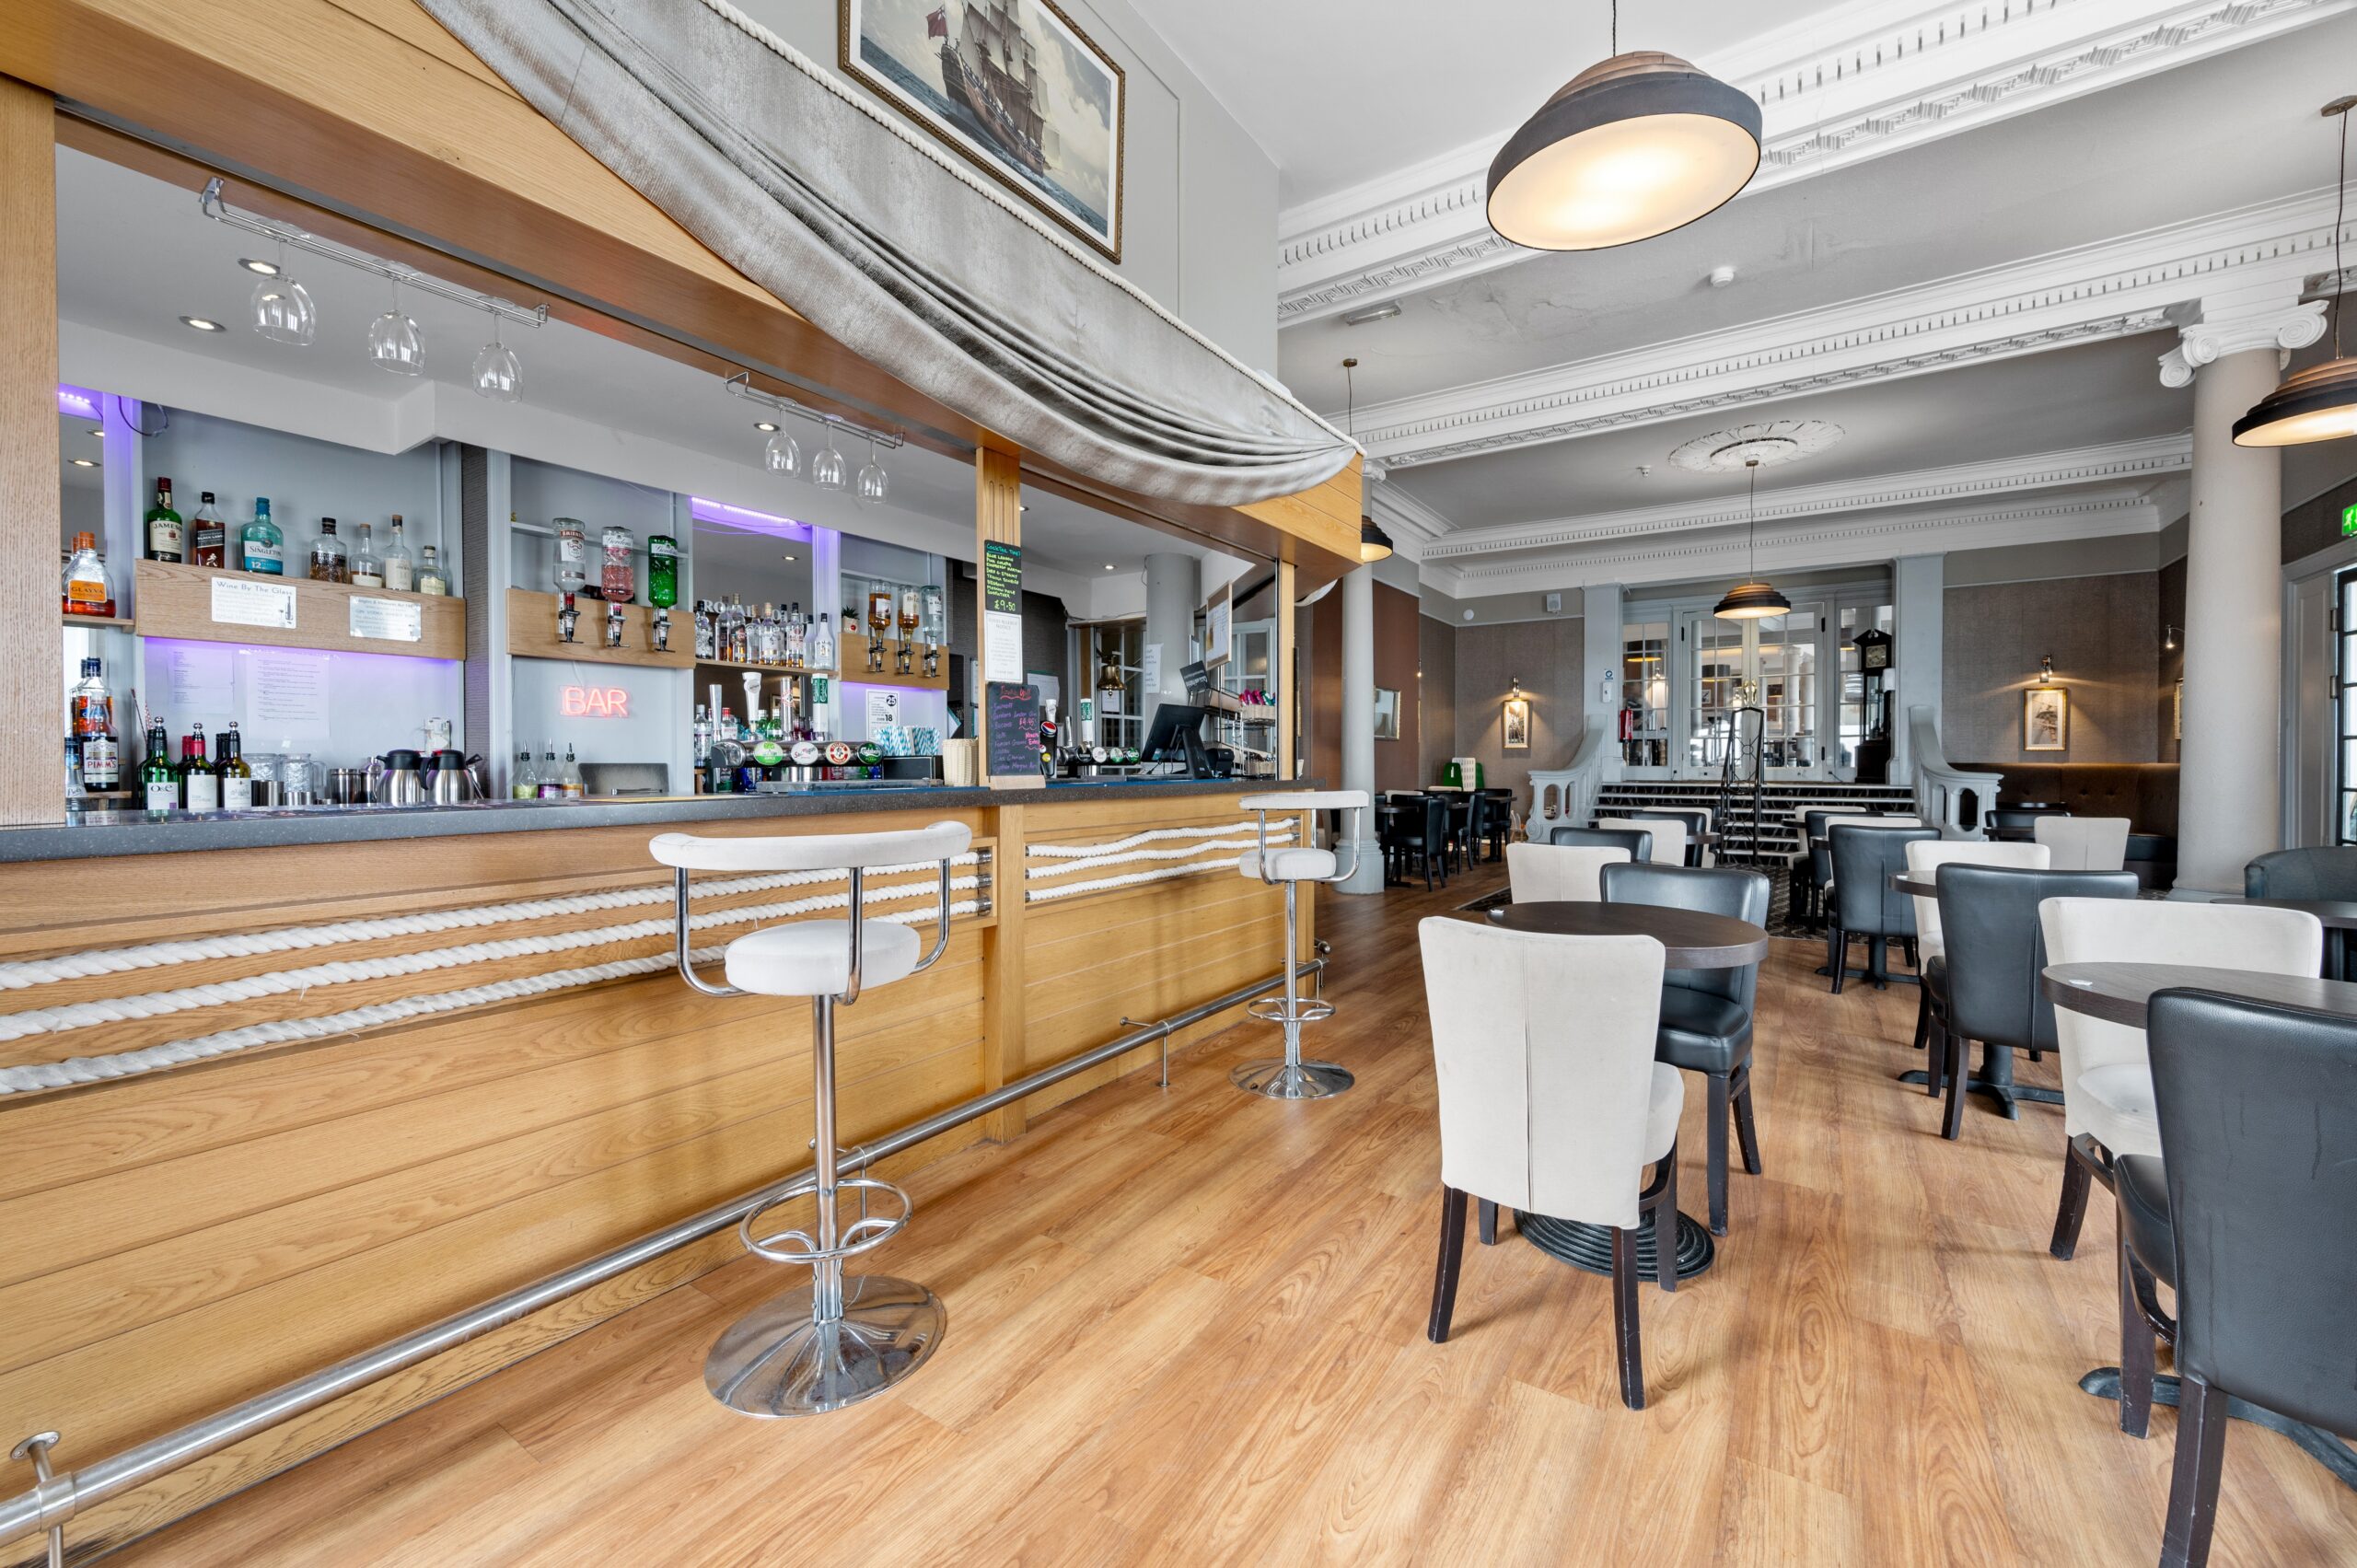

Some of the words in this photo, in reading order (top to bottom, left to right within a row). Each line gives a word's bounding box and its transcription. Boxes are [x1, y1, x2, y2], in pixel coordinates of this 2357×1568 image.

[154, 522, 182, 532] JAMESO
[216, 581, 238, 589] Wine
[241, 584, 251, 592] By
[255, 585, 269, 593] The
[563, 686, 630, 717] BAR
[887, 696, 896, 704] 25
[885, 714, 893, 722] 18
[87, 760, 117, 769] PIMM'S
